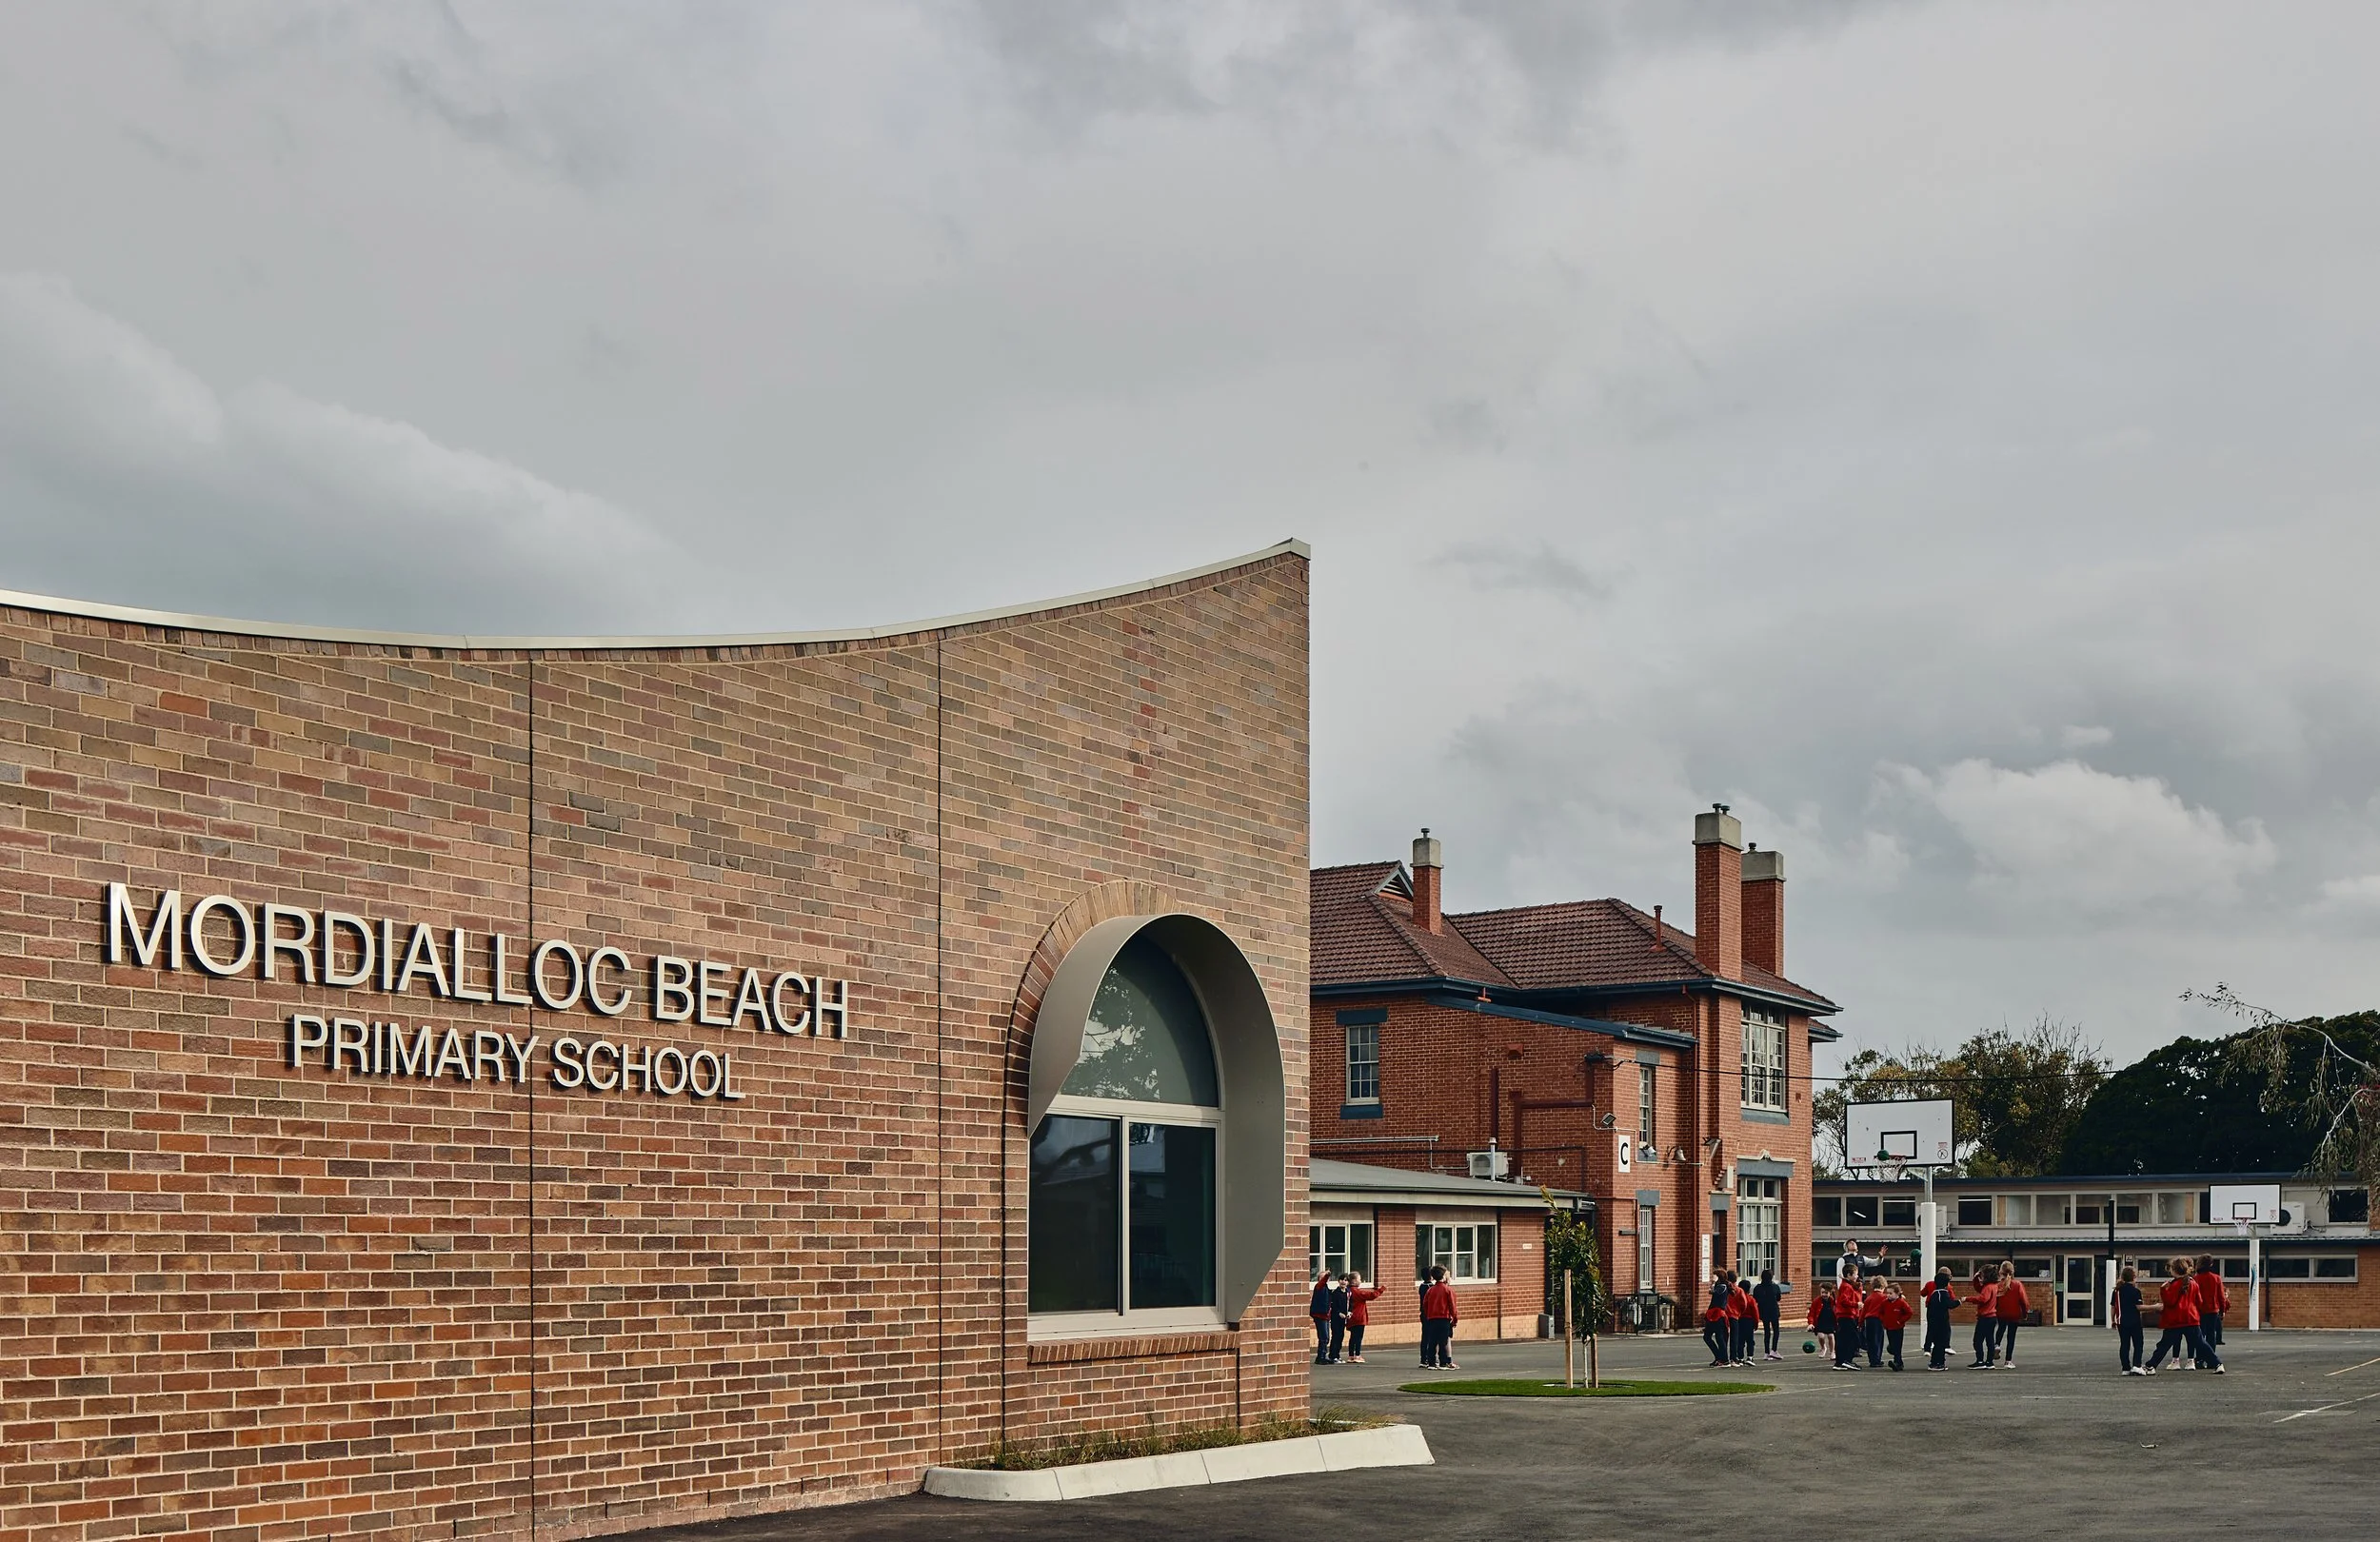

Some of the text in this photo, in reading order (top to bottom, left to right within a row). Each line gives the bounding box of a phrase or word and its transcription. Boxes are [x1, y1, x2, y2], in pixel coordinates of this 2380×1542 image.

[109, 881, 849, 1038] MORDIALLOC BEACH
[293, 1014, 746, 1099] PRIMARY SCHOOL
[1620, 1142, 1629, 1165] C
